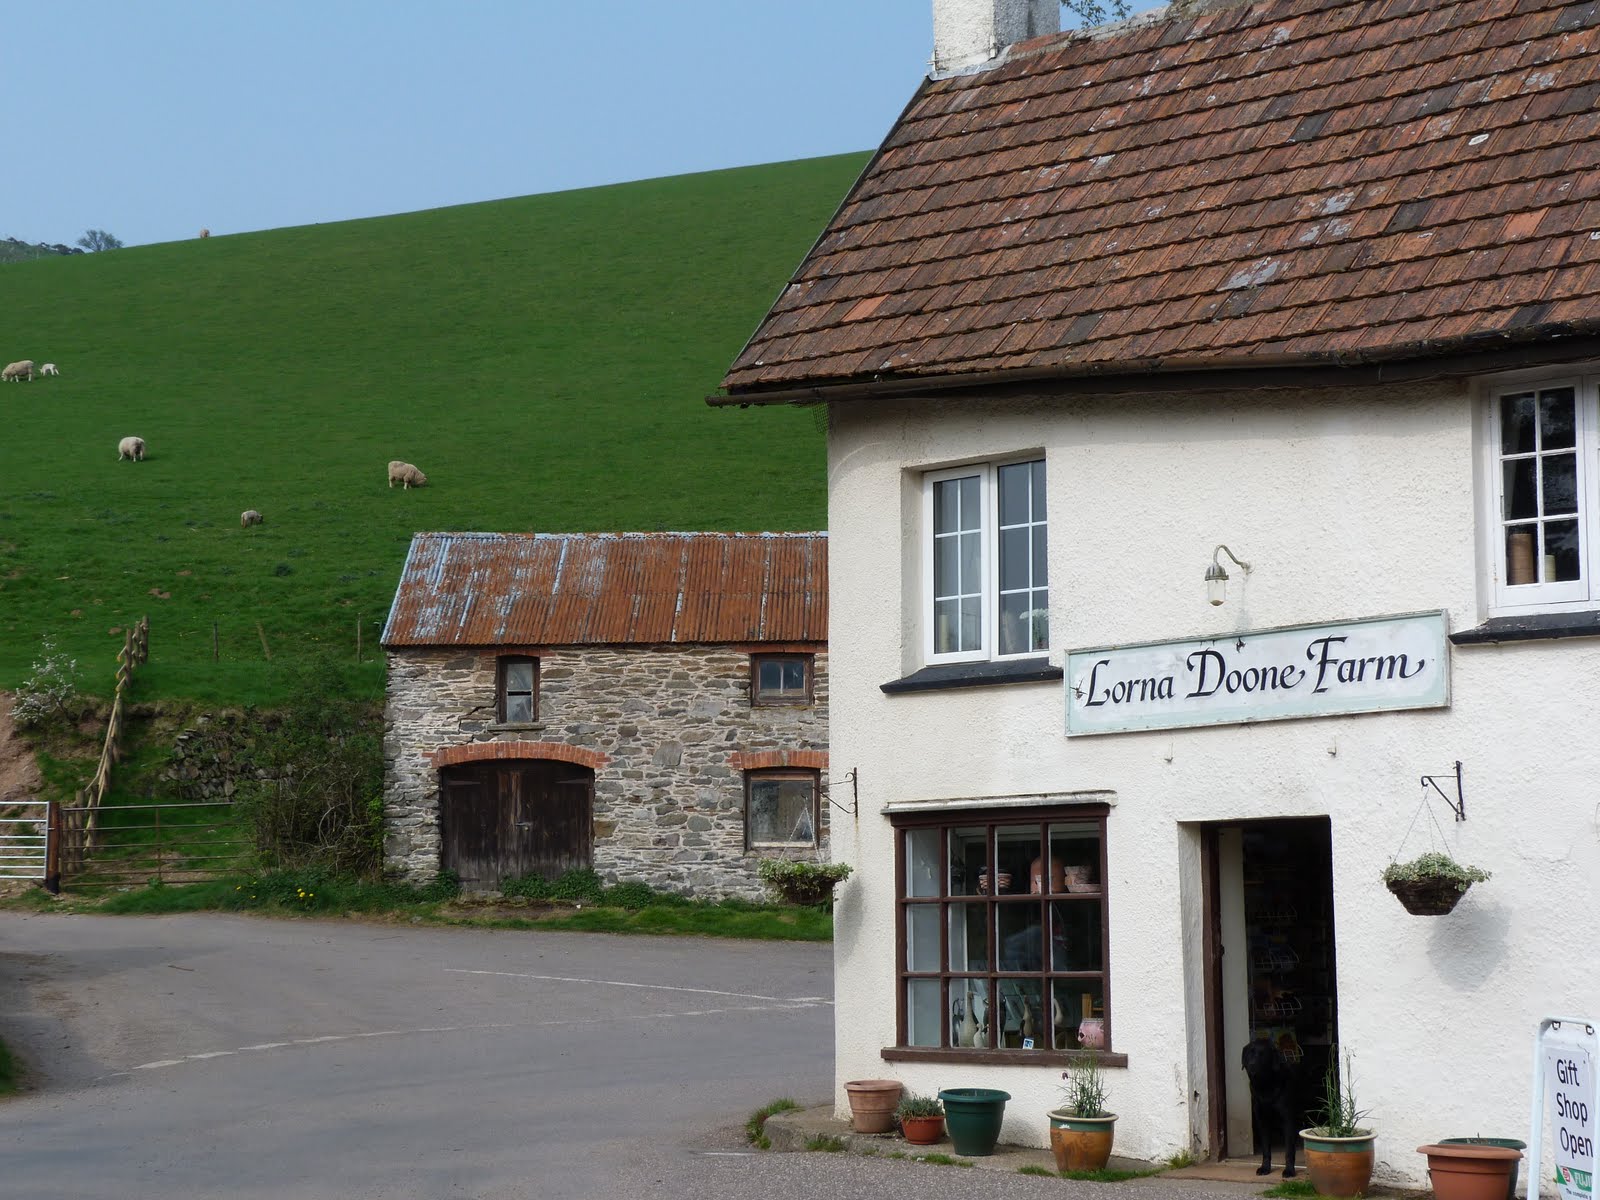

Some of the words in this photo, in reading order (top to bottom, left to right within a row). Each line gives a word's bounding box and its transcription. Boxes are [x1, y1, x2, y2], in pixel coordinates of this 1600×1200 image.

[1084, 659, 1174, 707] Lorna
[1186, 648, 1305, 699] Doone
[1306, 635, 1425, 694] Farm
[1556, 1059, 1580, 1087] Gift
[1556, 1092, 1588, 1128] Shop
[1560, 1127, 1593, 1159] Open
